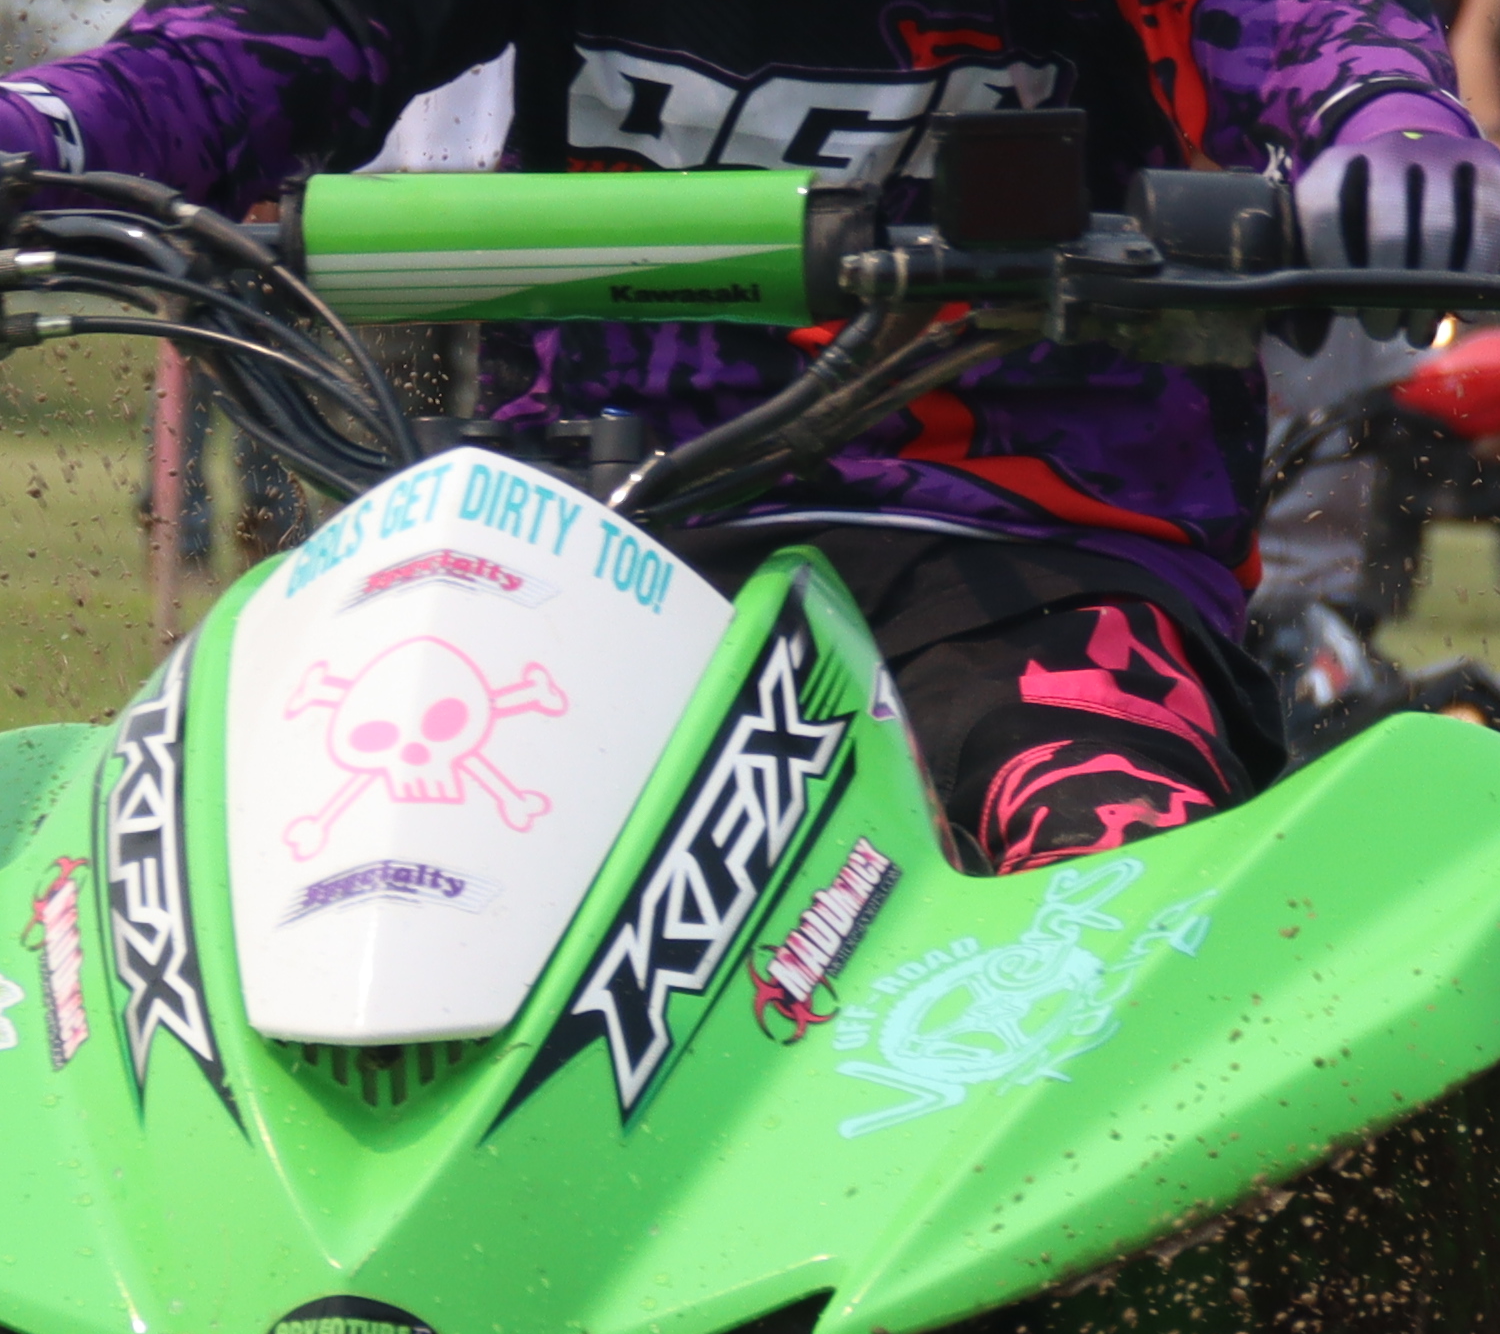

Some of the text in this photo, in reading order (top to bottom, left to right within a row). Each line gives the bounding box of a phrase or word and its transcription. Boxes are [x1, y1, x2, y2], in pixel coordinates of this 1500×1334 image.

[609, 284, 762, 304] Kawasaki
[379, 463, 455, 540] GET
[459, 463, 583, 558] DIRTY
[593, 519, 675, 615] TOO!
[107, 629, 214, 1085] KFX
[573, 634, 850, 1109] KFX
[832, 936, 983, 1052] OFF-ROAD
